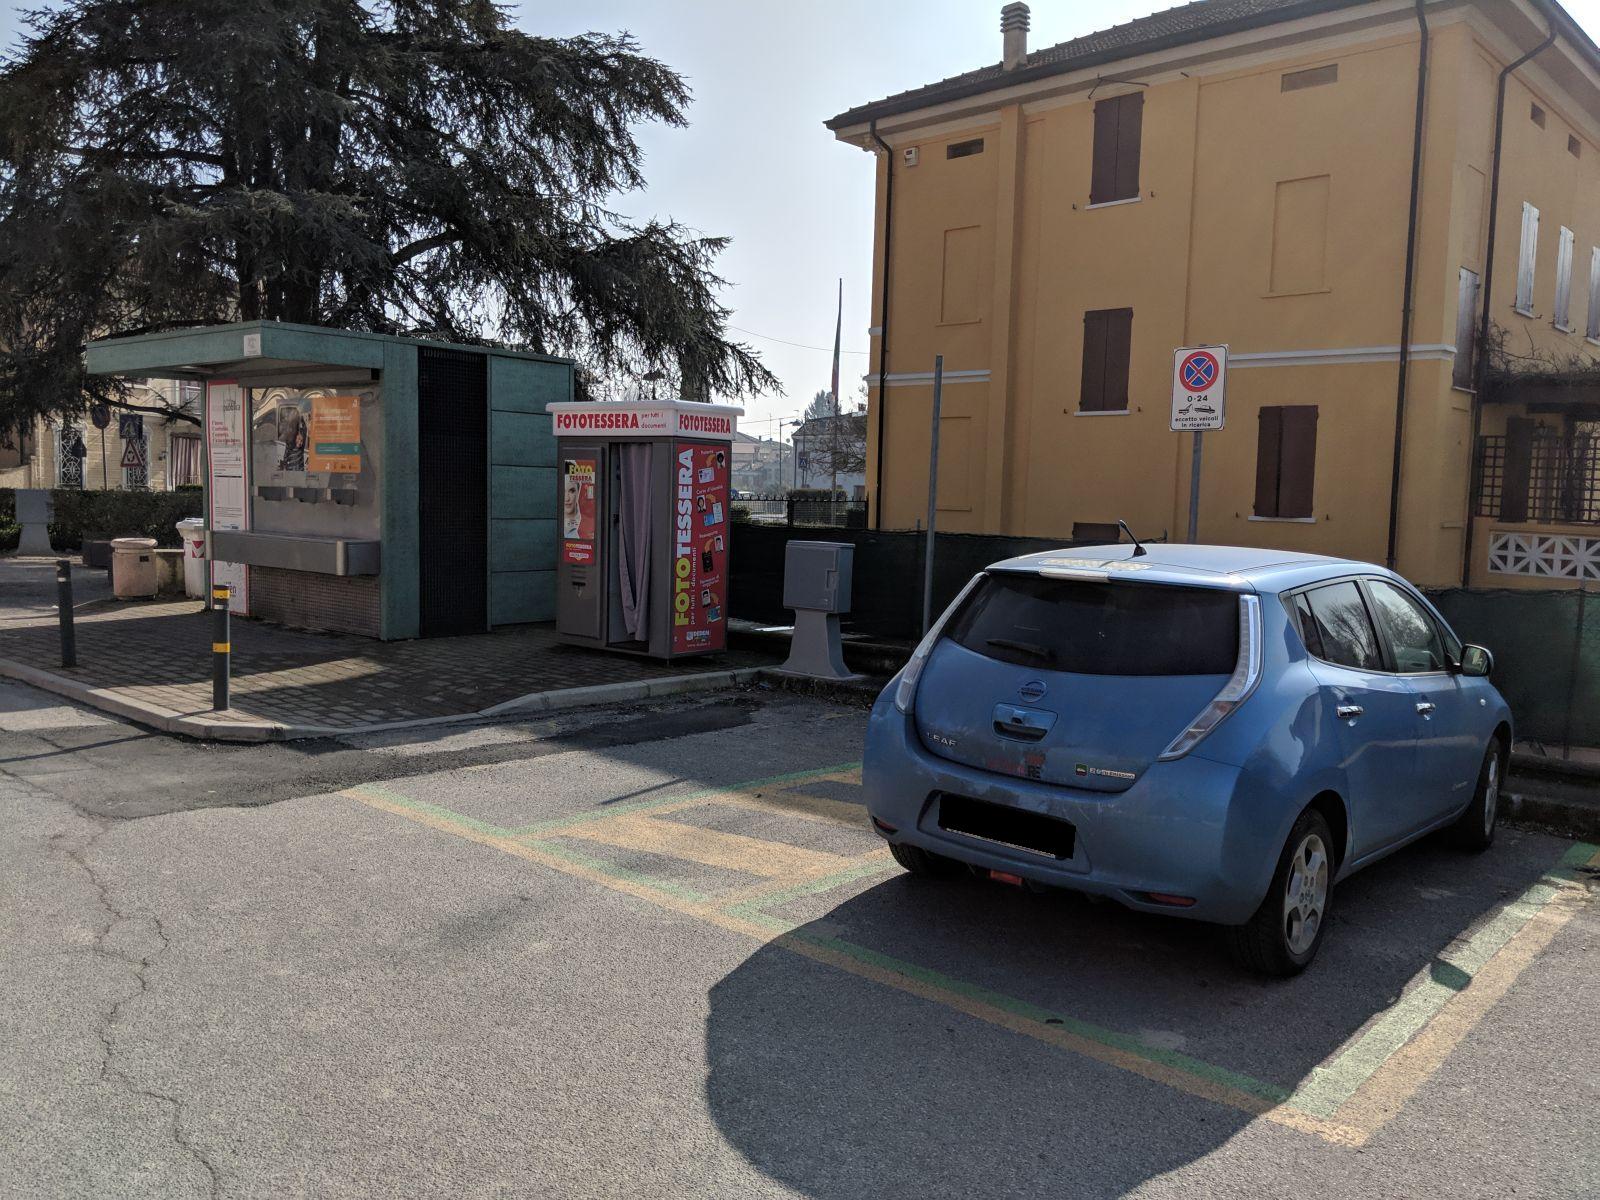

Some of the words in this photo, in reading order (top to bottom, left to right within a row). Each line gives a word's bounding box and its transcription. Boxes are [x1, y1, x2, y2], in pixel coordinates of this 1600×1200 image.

[557, 413, 639, 429] FOTOTESSERA
[679, 414, 731, 434] FOTOTESSERA
[568, 464, 593, 475] FOTO
[927, 732, 957, 747] LEAF
